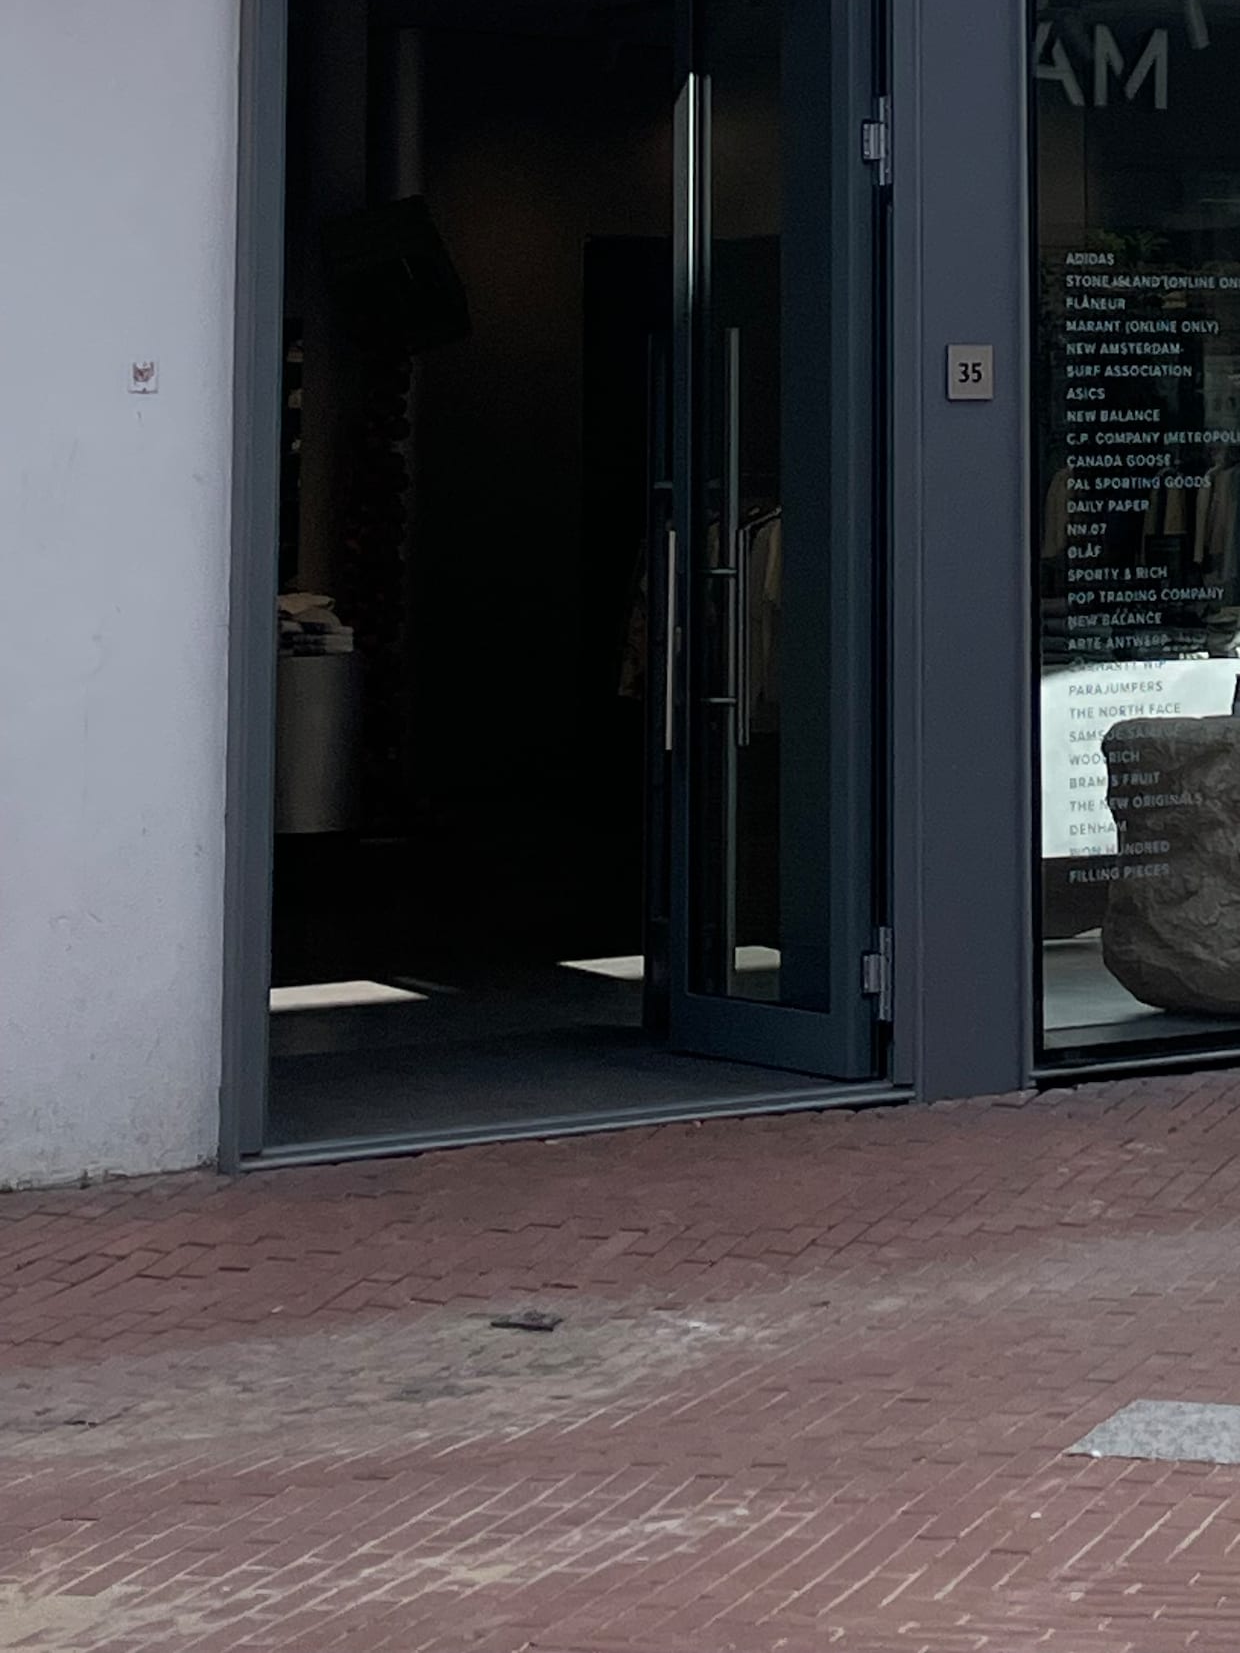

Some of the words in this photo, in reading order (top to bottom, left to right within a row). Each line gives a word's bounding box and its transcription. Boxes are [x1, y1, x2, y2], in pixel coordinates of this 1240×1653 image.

[1066, 252, 1115, 265] ADIDAS
[1066, 275, 1109, 288] STONE
[1112, 275, 1160, 288] ISLAND
[1066, 321, 1120, 333] MARANT
[1125, 321, 1176, 334] (ONLINE
[1181, 321, 1219, 334] ONLY)
[1066, 343, 1096, 355] NEW
[958, 362, 982, 383] 35
[1066, 365, 1100, 377] SURF
[1104, 365, 1192, 377] ASSOCIATION
[1066, 388, 1105, 400] ASICS
[1066, 410, 1096, 422] NEW
[1100, 409, 1160, 422] BALANCE
[1095, 432, 1160, 444] COMPANY
[1067, 455, 1122, 467] CANADA
[1126, 454, 1171, 467] GOOSE
[1067, 478, 1090, 490] PAL
[1095, 477, 1160, 489] SPORTING
[1165, 476, 1211, 488] GOODS
[1067, 501, 1103, 513] DAILY
[1108, 500, 1149, 512] PAPER
[1067, 523, 1107, 536] NN.07
[1068, 568, 1120, 582] SPORTY
[1136, 566, 1168, 579] RICH
[1068, 592, 1095, 604] POP
[1100, 590, 1157, 603] TRADING
[1161, 588, 1225, 601] COMPANY
[1068, 616, 1098, 629] NEW
[1102, 613, 1162, 627] BALANCE
[1068, 638, 1101, 650] ARTE
[1068, 680, 1163, 695] PARAJUMPERS
[1069, 707, 1093, 719] THE
[1099, 705, 1144, 718] NORTH
[1149, 702, 1181, 715] FACE
[1122, 771, 1160, 785] FRUIT
[1069, 800, 1095, 812] THE
[1132, 794, 1203, 809] ORIGINALS
[1069, 821, 1128, 836] DENHAM
[1069, 867, 1120, 883] FILLING
[1123, 863, 1170, 878] PIECES
